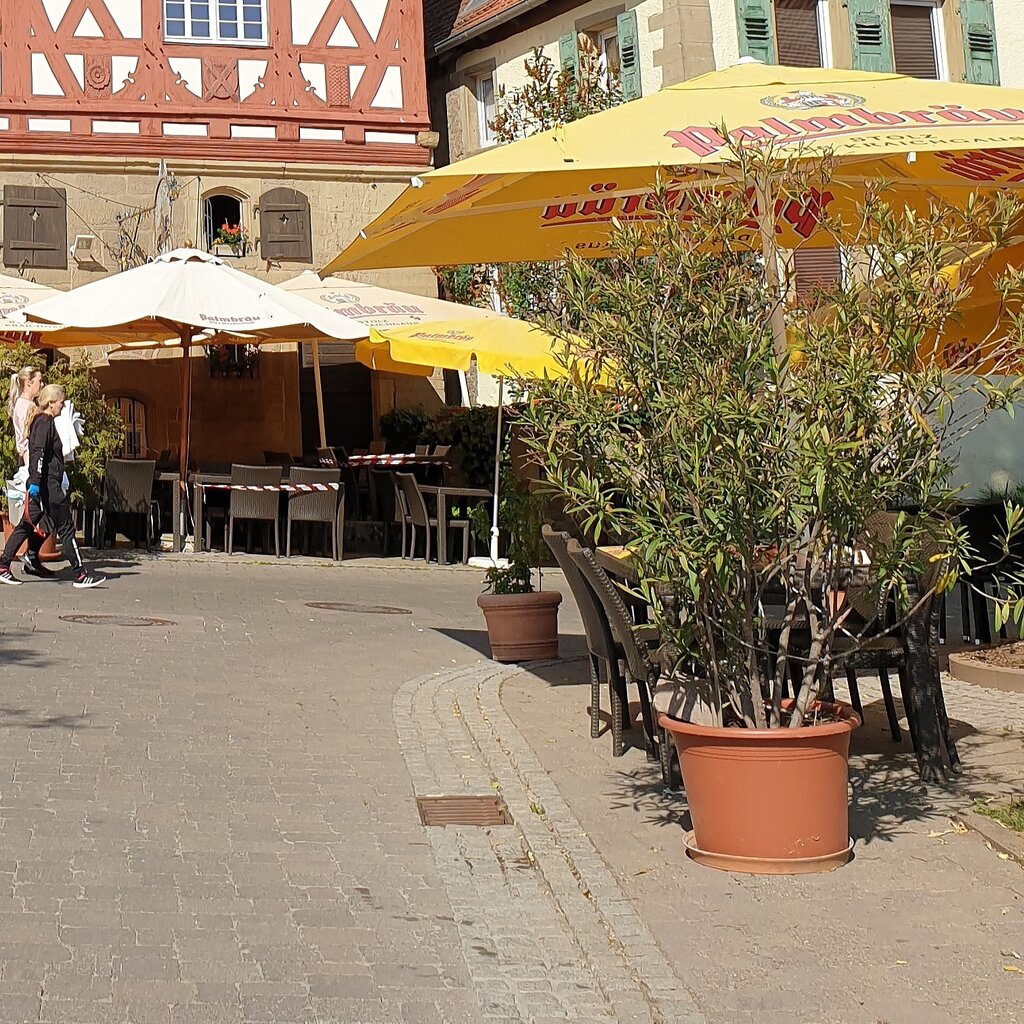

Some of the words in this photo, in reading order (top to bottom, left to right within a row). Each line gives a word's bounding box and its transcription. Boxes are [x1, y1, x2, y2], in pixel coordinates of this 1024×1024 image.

[663, 105, 1024, 157] Palmbräu
[849, 134, 938, 143] STOLZ
[333, 302, 425, 317] mbräu
